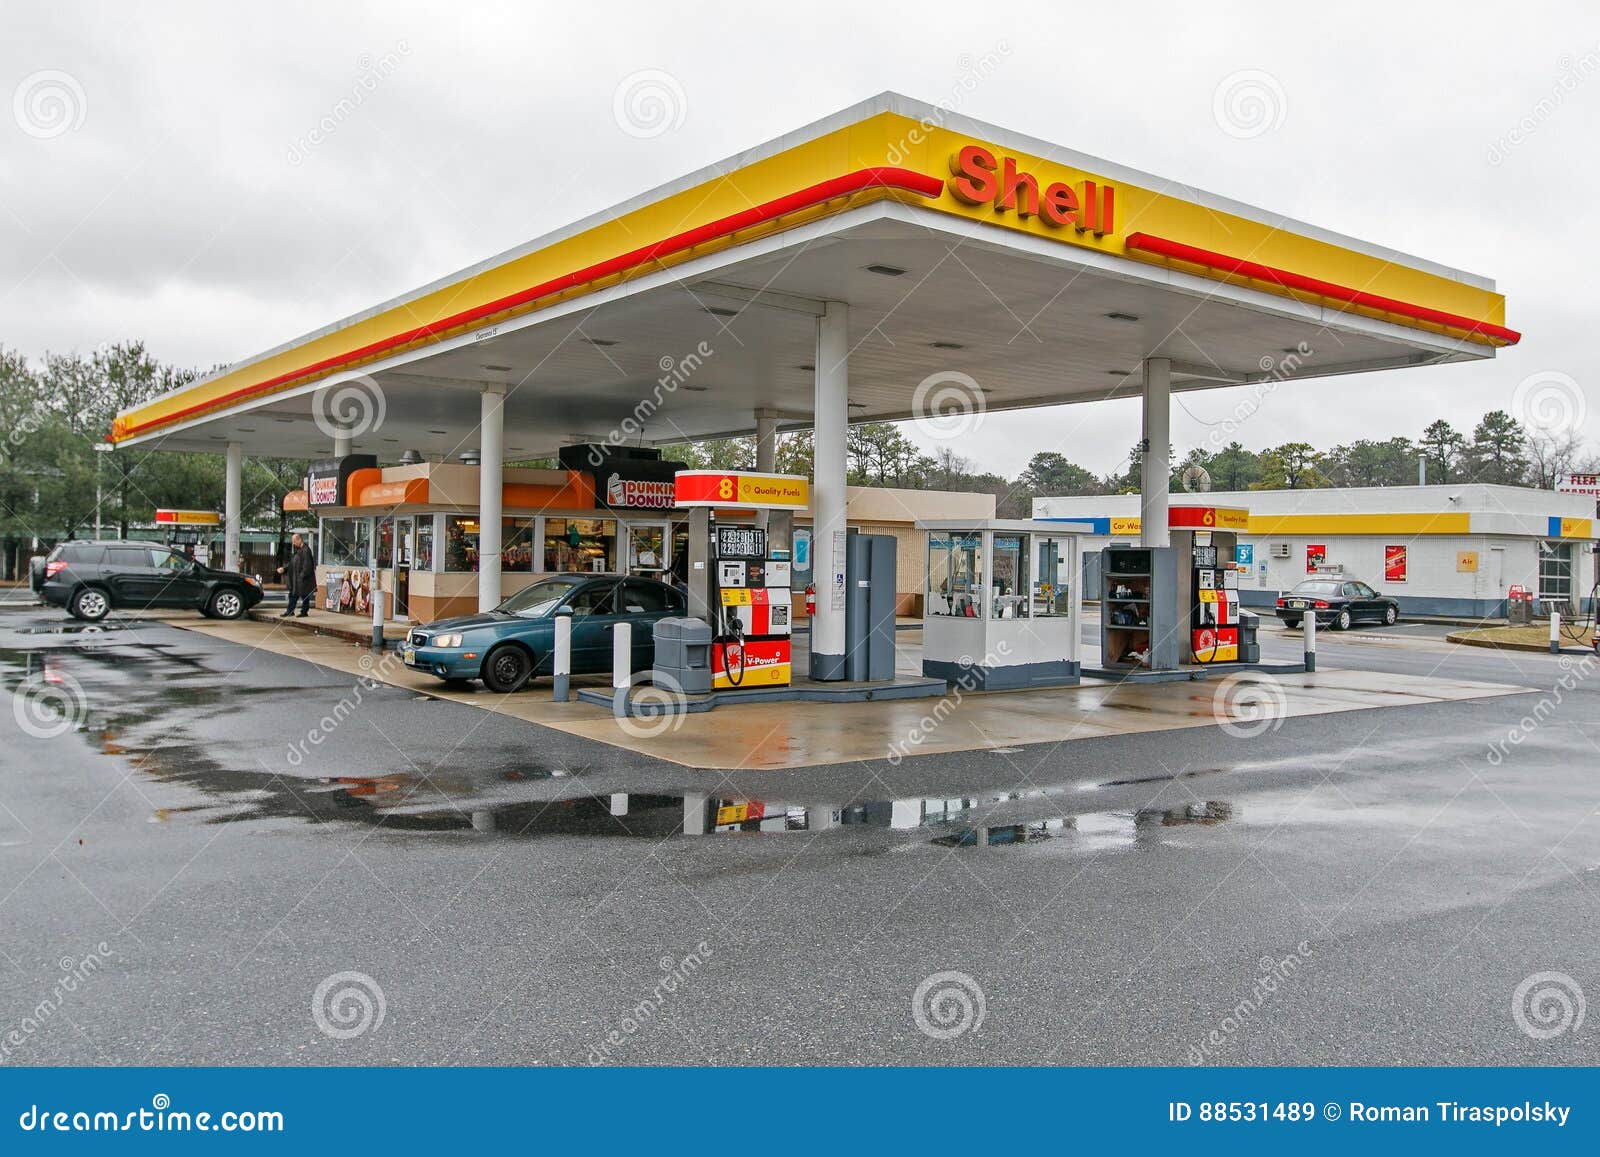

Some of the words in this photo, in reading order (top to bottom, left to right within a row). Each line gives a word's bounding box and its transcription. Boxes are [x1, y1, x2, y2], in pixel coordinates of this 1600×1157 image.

[948, 145, 1115, 238] Shell
[1570, 475, 1597, 486] FLEA
[719, 478, 733, 499] 8
[754, 486, 781, 497] Quality
[783, 488, 800, 497] Fuels
[626, 494, 675, 508] DONUTS
[1203, 510, 1213, 526] 6
[1113, 522, 1126, 530] Car
[1127, 522, 1141, 530] Was
[747, 657, 780, 665] V-Power
